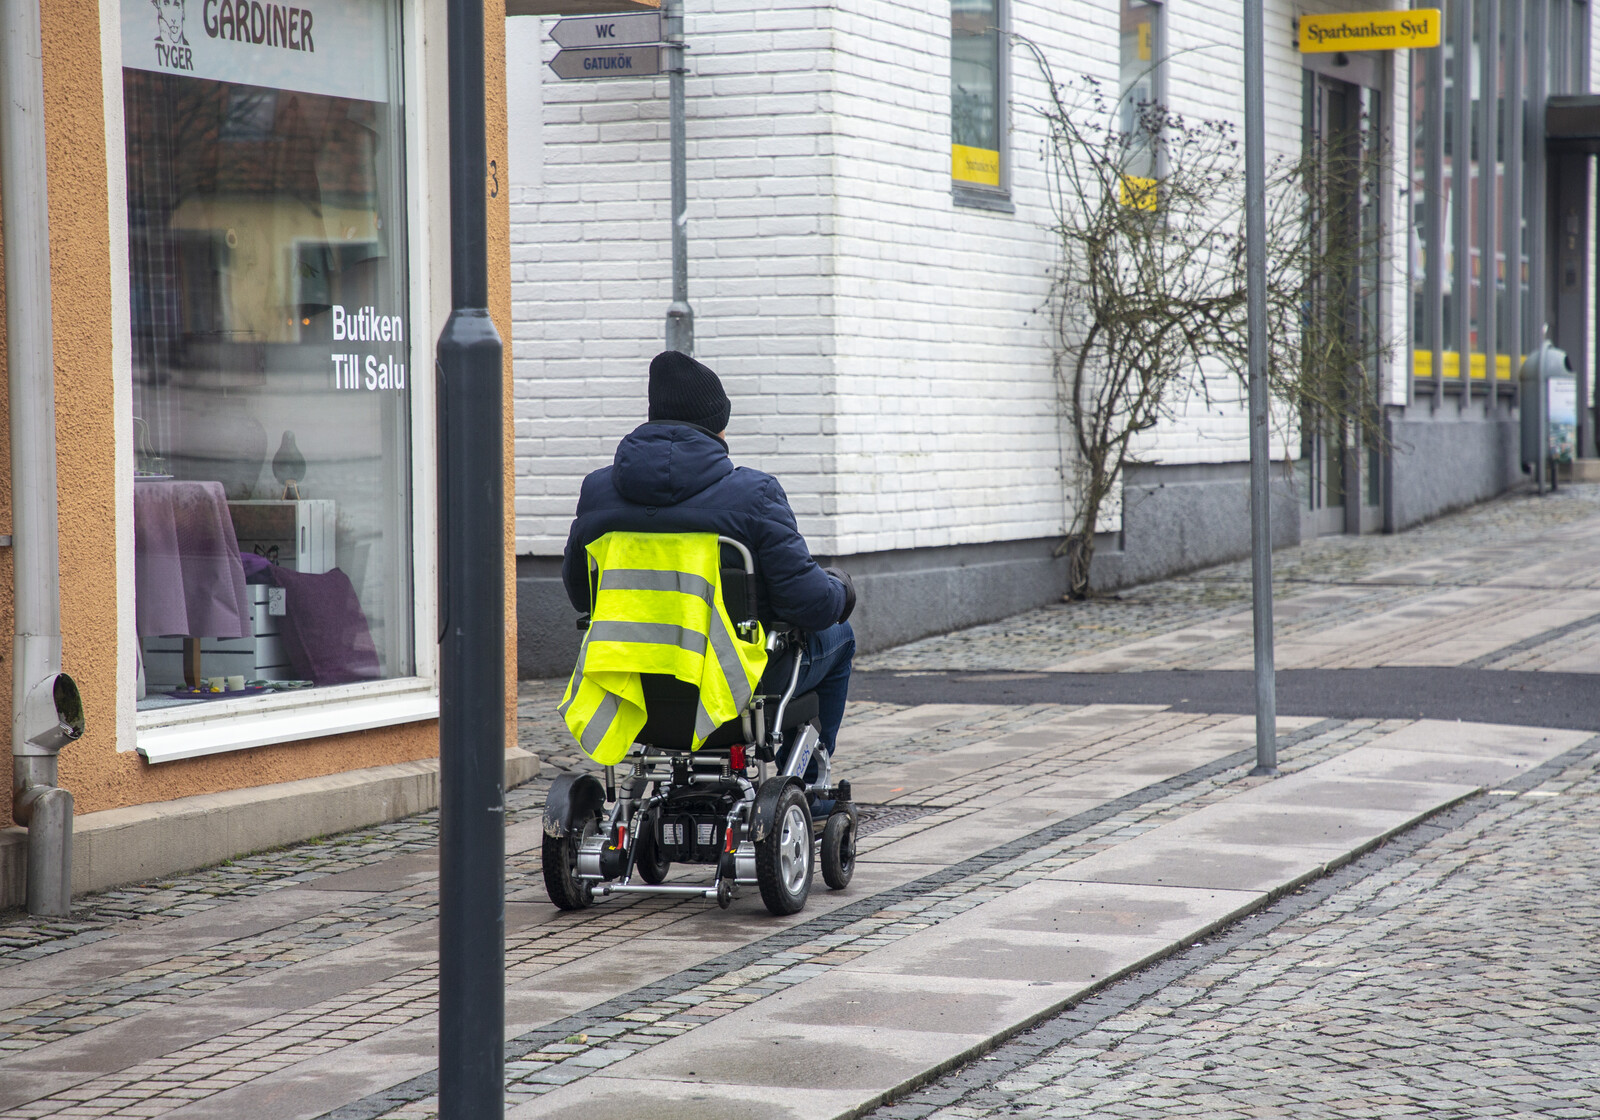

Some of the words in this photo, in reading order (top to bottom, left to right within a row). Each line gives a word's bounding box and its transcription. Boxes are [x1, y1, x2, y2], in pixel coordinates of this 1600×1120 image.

[202, 0, 315, 52] GARDINER
[595, 23, 616, 38] WC
[1307, 22, 1396, 44] Sparbanken
[1400, 19, 1428, 39] Syd
[154, 43, 194, 71] TYGER
[583, 52, 632, 70] GATUKÖK
[490, 160, 499, 199] 3
[332, 304, 403, 342] Butiken
[331, 353, 360, 390] Till
[364, 354, 405, 391] Salu
